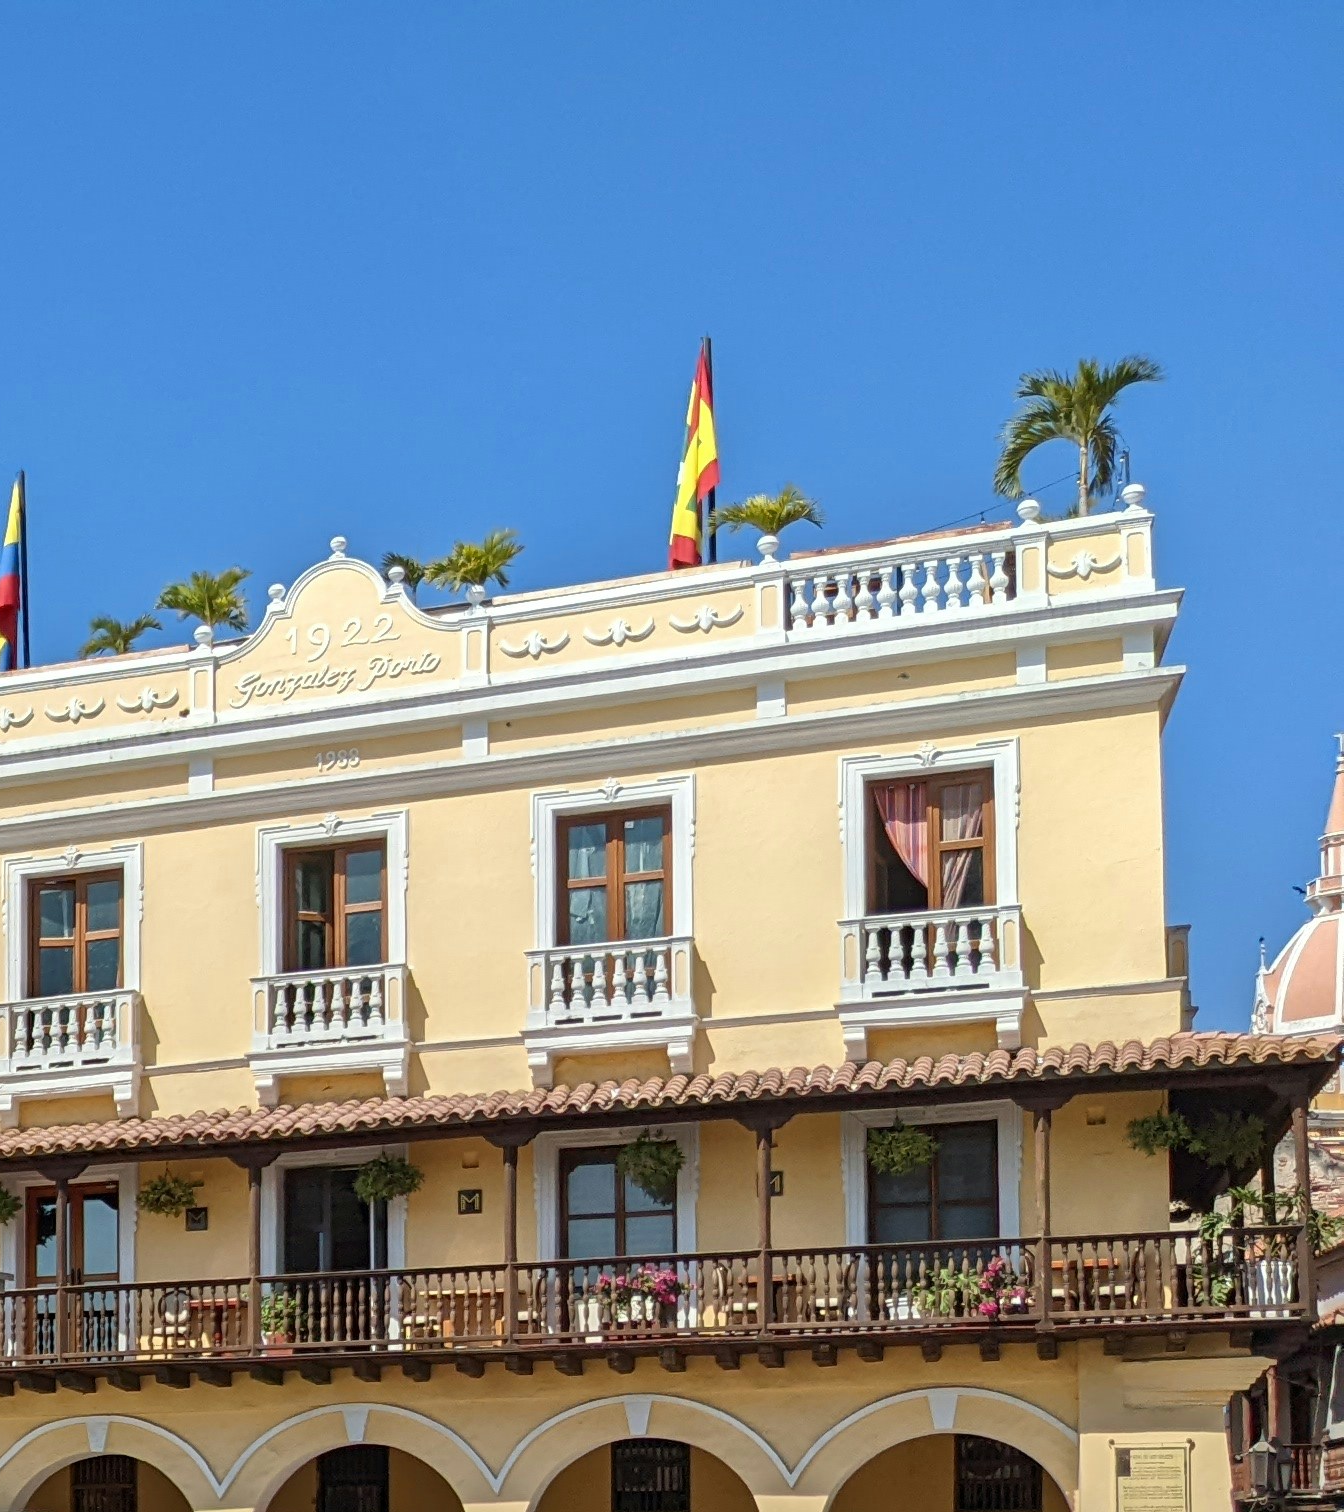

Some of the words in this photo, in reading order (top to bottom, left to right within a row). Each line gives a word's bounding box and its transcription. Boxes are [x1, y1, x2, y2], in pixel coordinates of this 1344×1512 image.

[285, 614, 401, 662] 1922
[229, 665, 357, 709] Gonzalez
[357, 651, 441, 691] Porto
[314, 748, 361, 771] 1988
[460, 1193, 480, 1212] M
